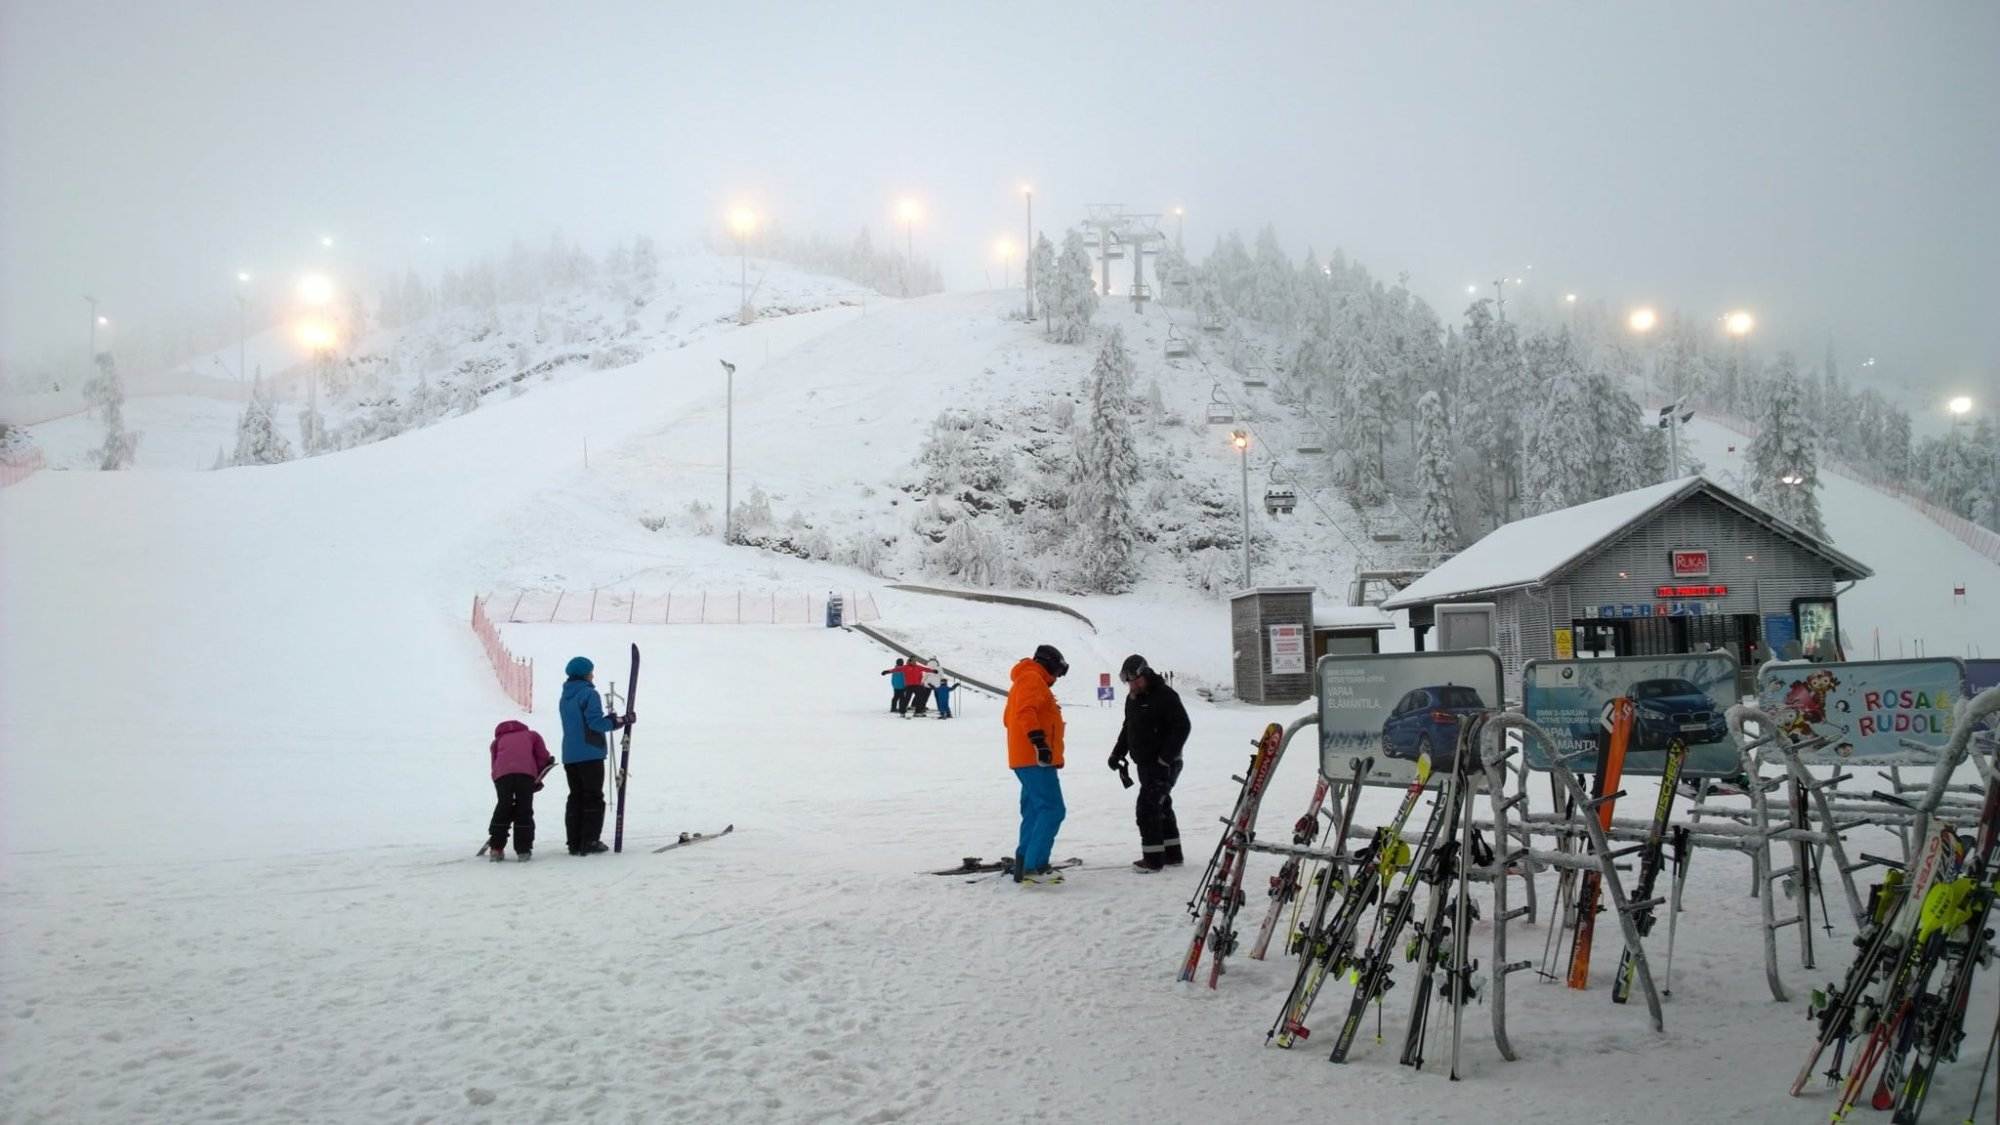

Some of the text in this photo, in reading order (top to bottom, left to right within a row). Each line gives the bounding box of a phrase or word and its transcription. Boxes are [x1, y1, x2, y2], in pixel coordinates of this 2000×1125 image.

[1328, 686, 1353, 697] VAPAA
[1864, 689, 1931, 711] ROSA
[1655, 755, 1681, 822] FISCHER
[1913, 835, 1940, 901] HEAD
